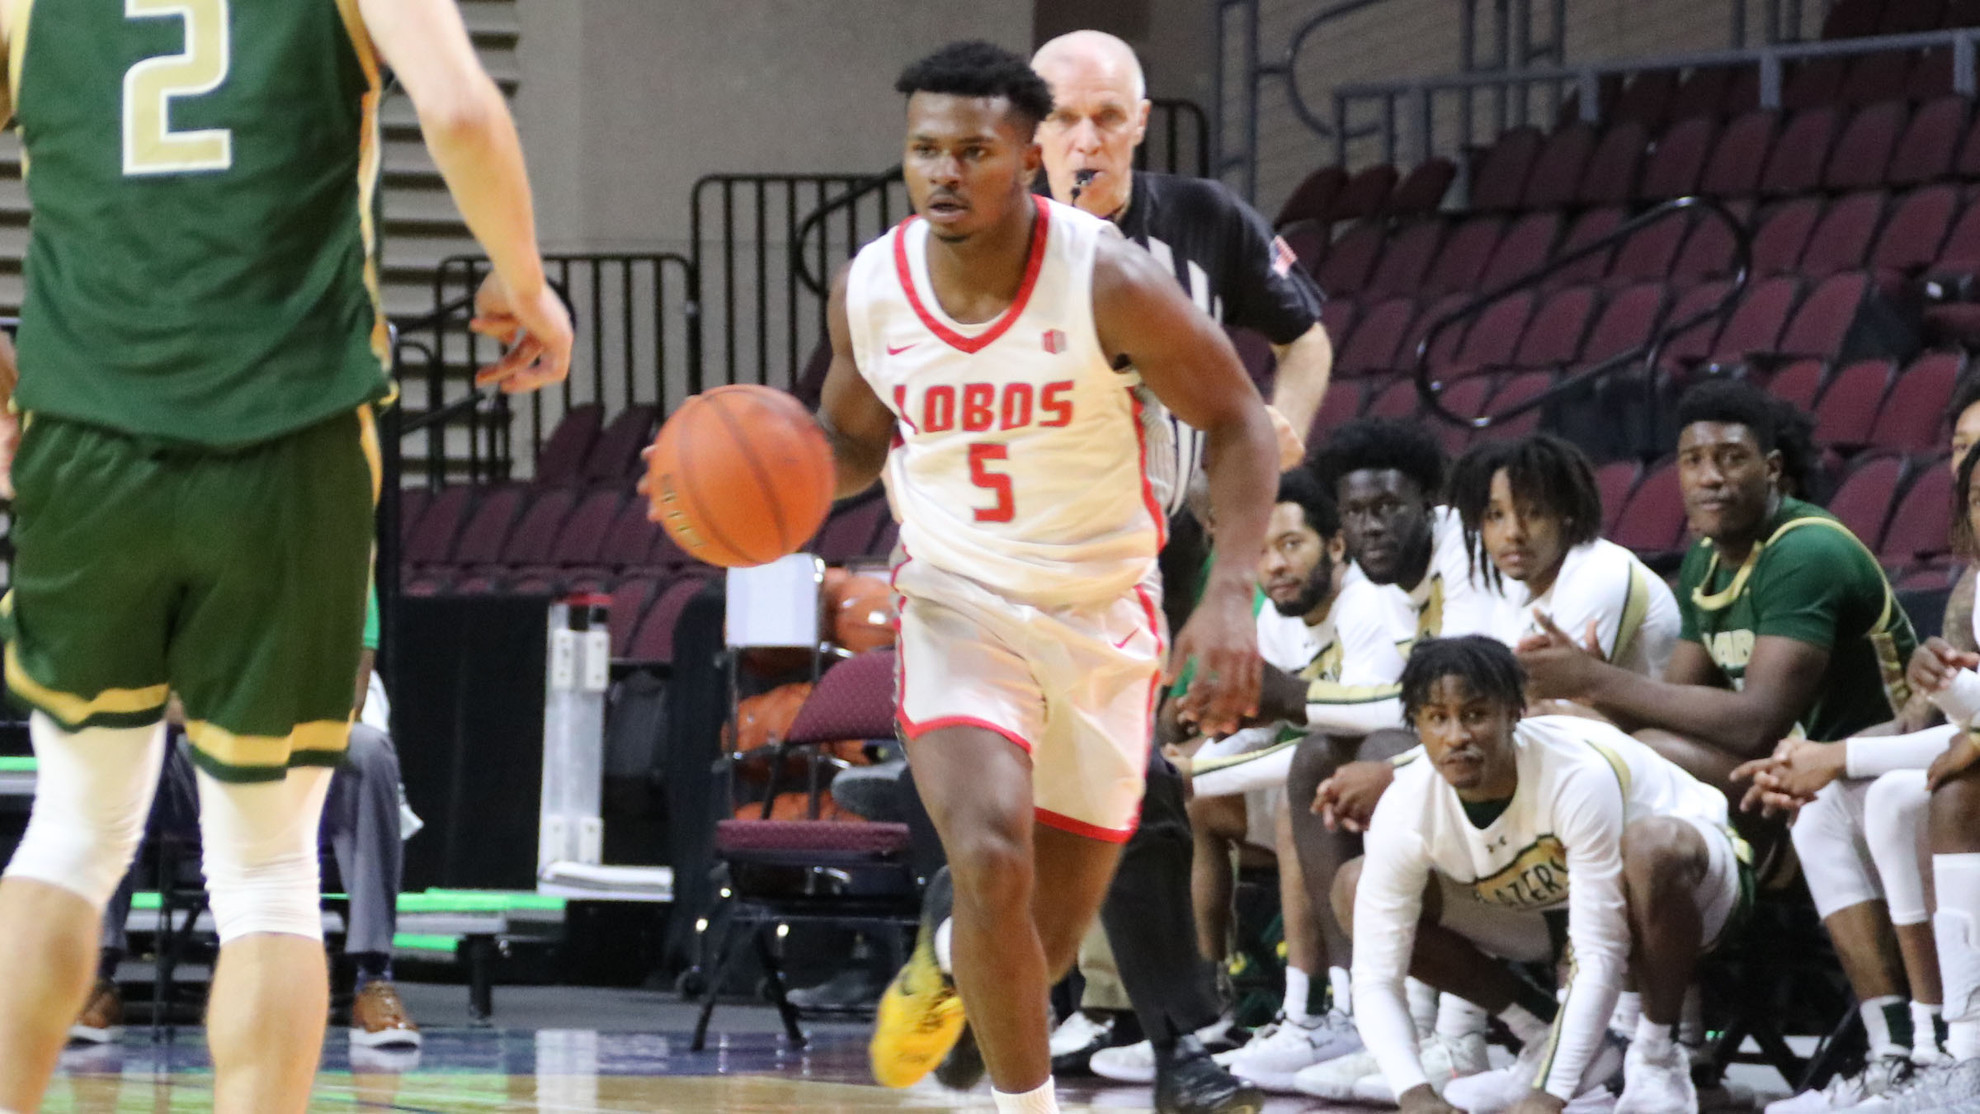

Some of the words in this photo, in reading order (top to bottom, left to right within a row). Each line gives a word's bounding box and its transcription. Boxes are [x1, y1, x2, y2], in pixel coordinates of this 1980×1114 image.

[124, 0, 233, 175] 2
[894, 380, 1074, 434] LOBOS
[969, 443, 1016, 523] 5
